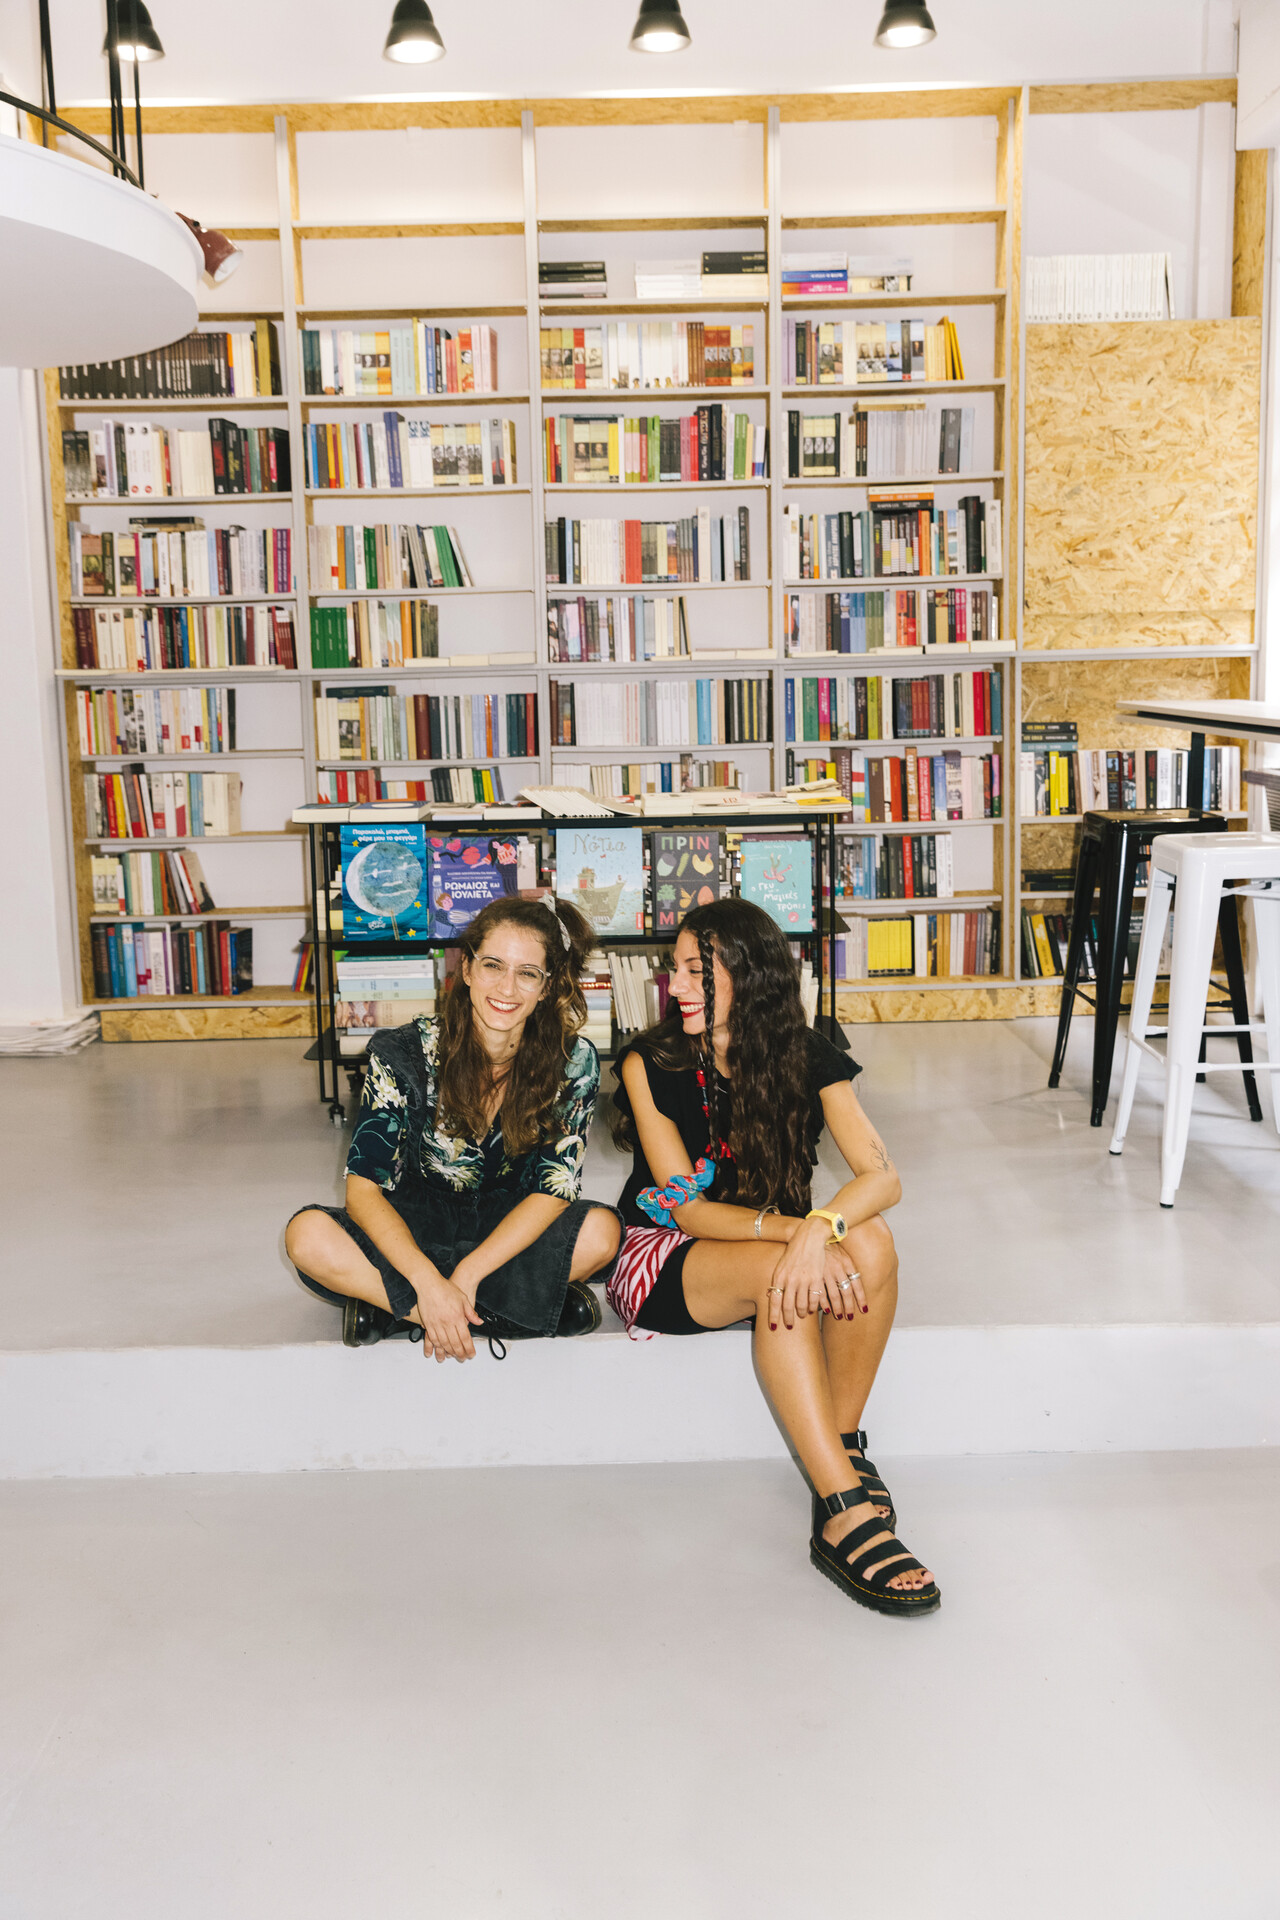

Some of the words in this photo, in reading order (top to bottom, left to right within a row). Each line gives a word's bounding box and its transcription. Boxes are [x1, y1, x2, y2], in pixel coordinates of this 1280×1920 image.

[661, 836, 709, 850] ΠΡΙΝ
[444, 882, 489, 890] ΡΩΜΑΙΟΣ
[451, 890, 493, 899] ΙΟΥΛΙΕΤΑ
